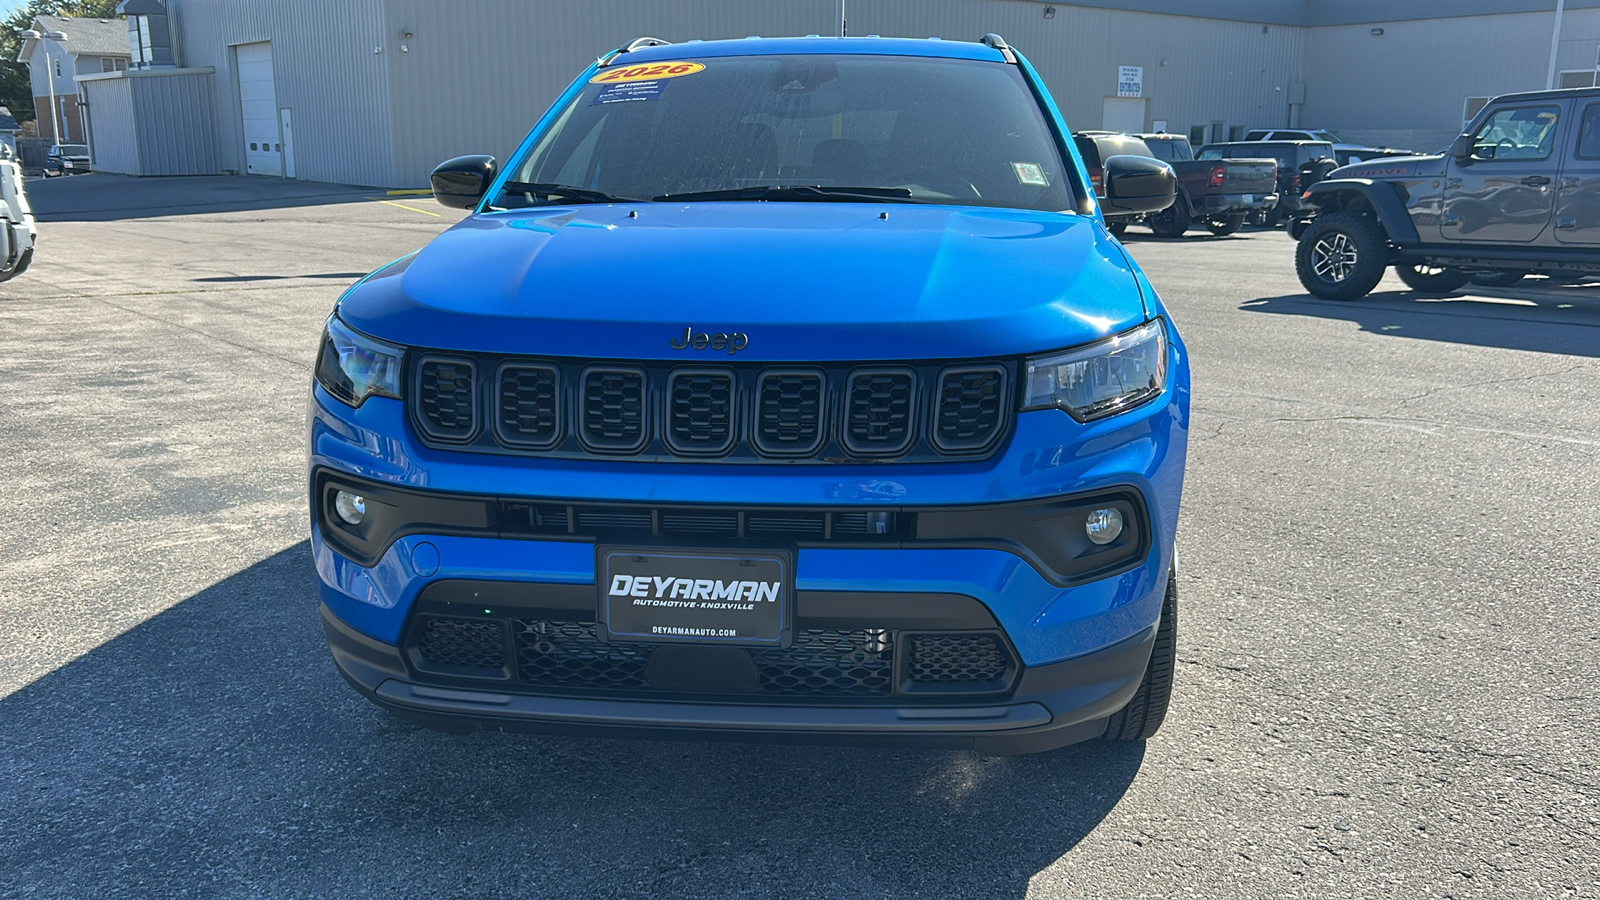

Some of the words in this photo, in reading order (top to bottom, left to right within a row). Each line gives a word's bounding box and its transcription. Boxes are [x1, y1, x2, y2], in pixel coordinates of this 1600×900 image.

[599, 64, 694, 81] 2026
[669, 326, 748, 355] Jeep
[608, 574, 781, 603] DEYARMAN
[632, 599, 755, 610] AUTOMOTIVE-KNOXVILLE
[652, 625, 736, 637] DEYARMANAUTO.COM
